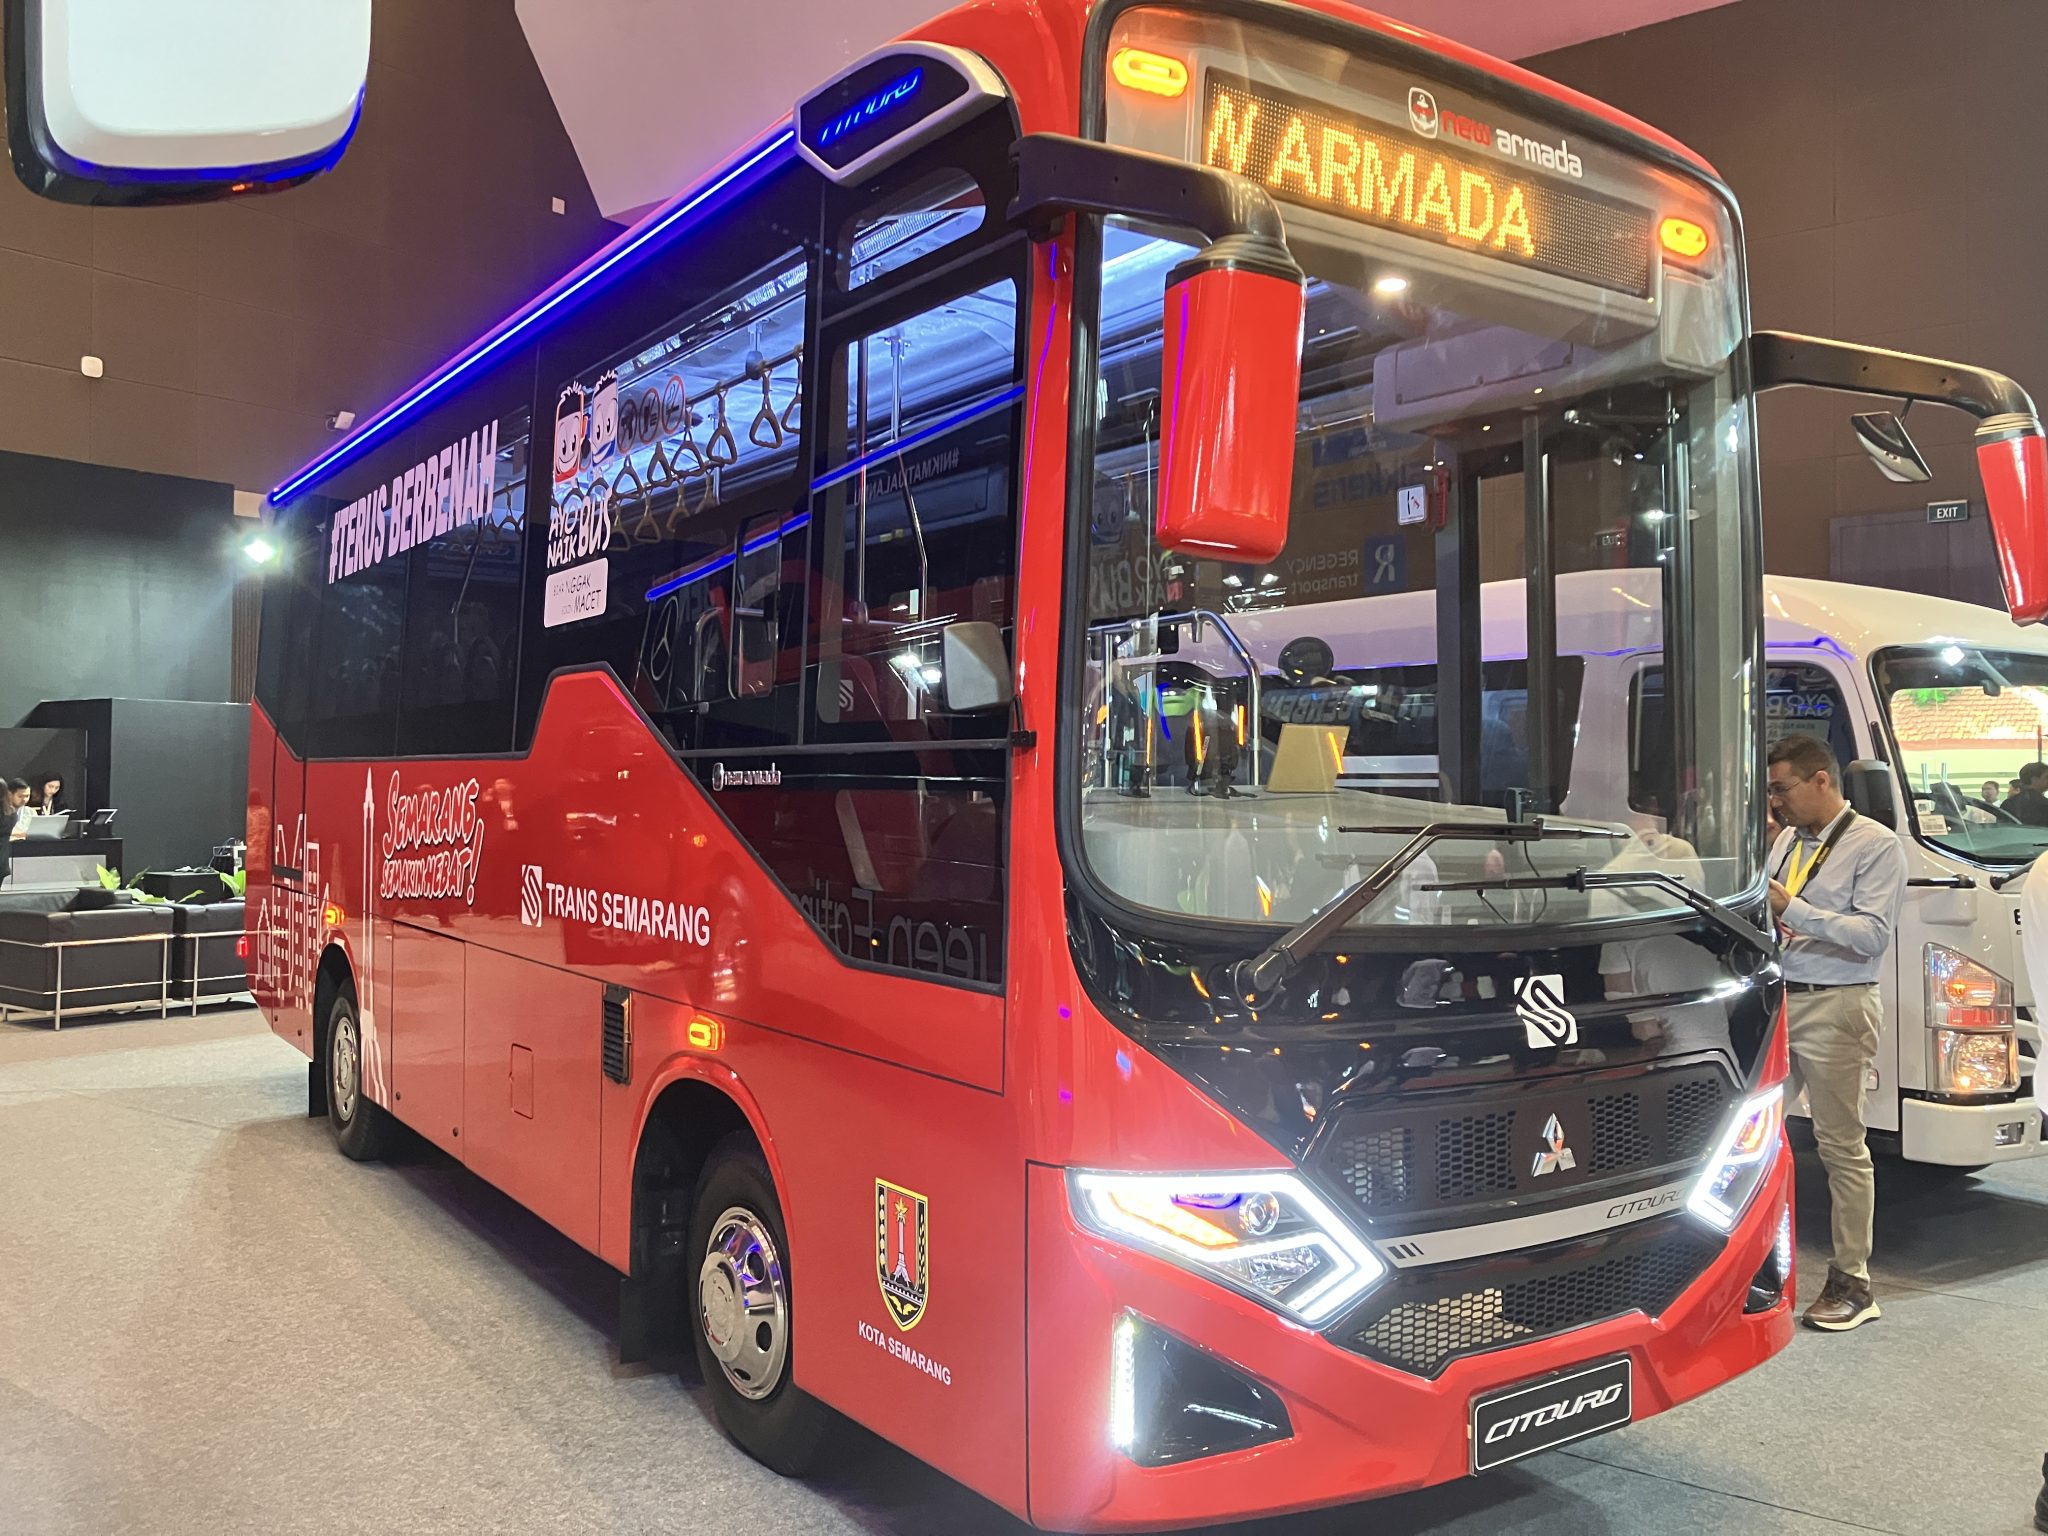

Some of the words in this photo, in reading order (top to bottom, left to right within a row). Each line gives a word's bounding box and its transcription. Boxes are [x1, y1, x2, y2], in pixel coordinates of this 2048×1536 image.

[1206, 93, 1260, 175] N
[1267, 116, 1536, 258] ARMADA
[1441, 111, 1491, 147] new
[1496, 128, 1583, 179] armada
[328, 484, 388, 585] #TERUS
[388, 419, 499, 558] BERBENAH
[547, 534, 577, 569] NAIK
[577, 488, 613, 557] BUS
[549, 500, 579, 541] AYO
[1936, 507, 1959, 520] EXIT
[383, 770, 480, 860] SEMARANG
[545, 882, 598, 924] TRANS
[601, 892, 711, 947] SEMARANG
[858, 1320, 887, 1350] KOTA
[888, 1336, 952, 1386] SEMARANG
[1484, 1382, 1624, 1445] CITOURO
